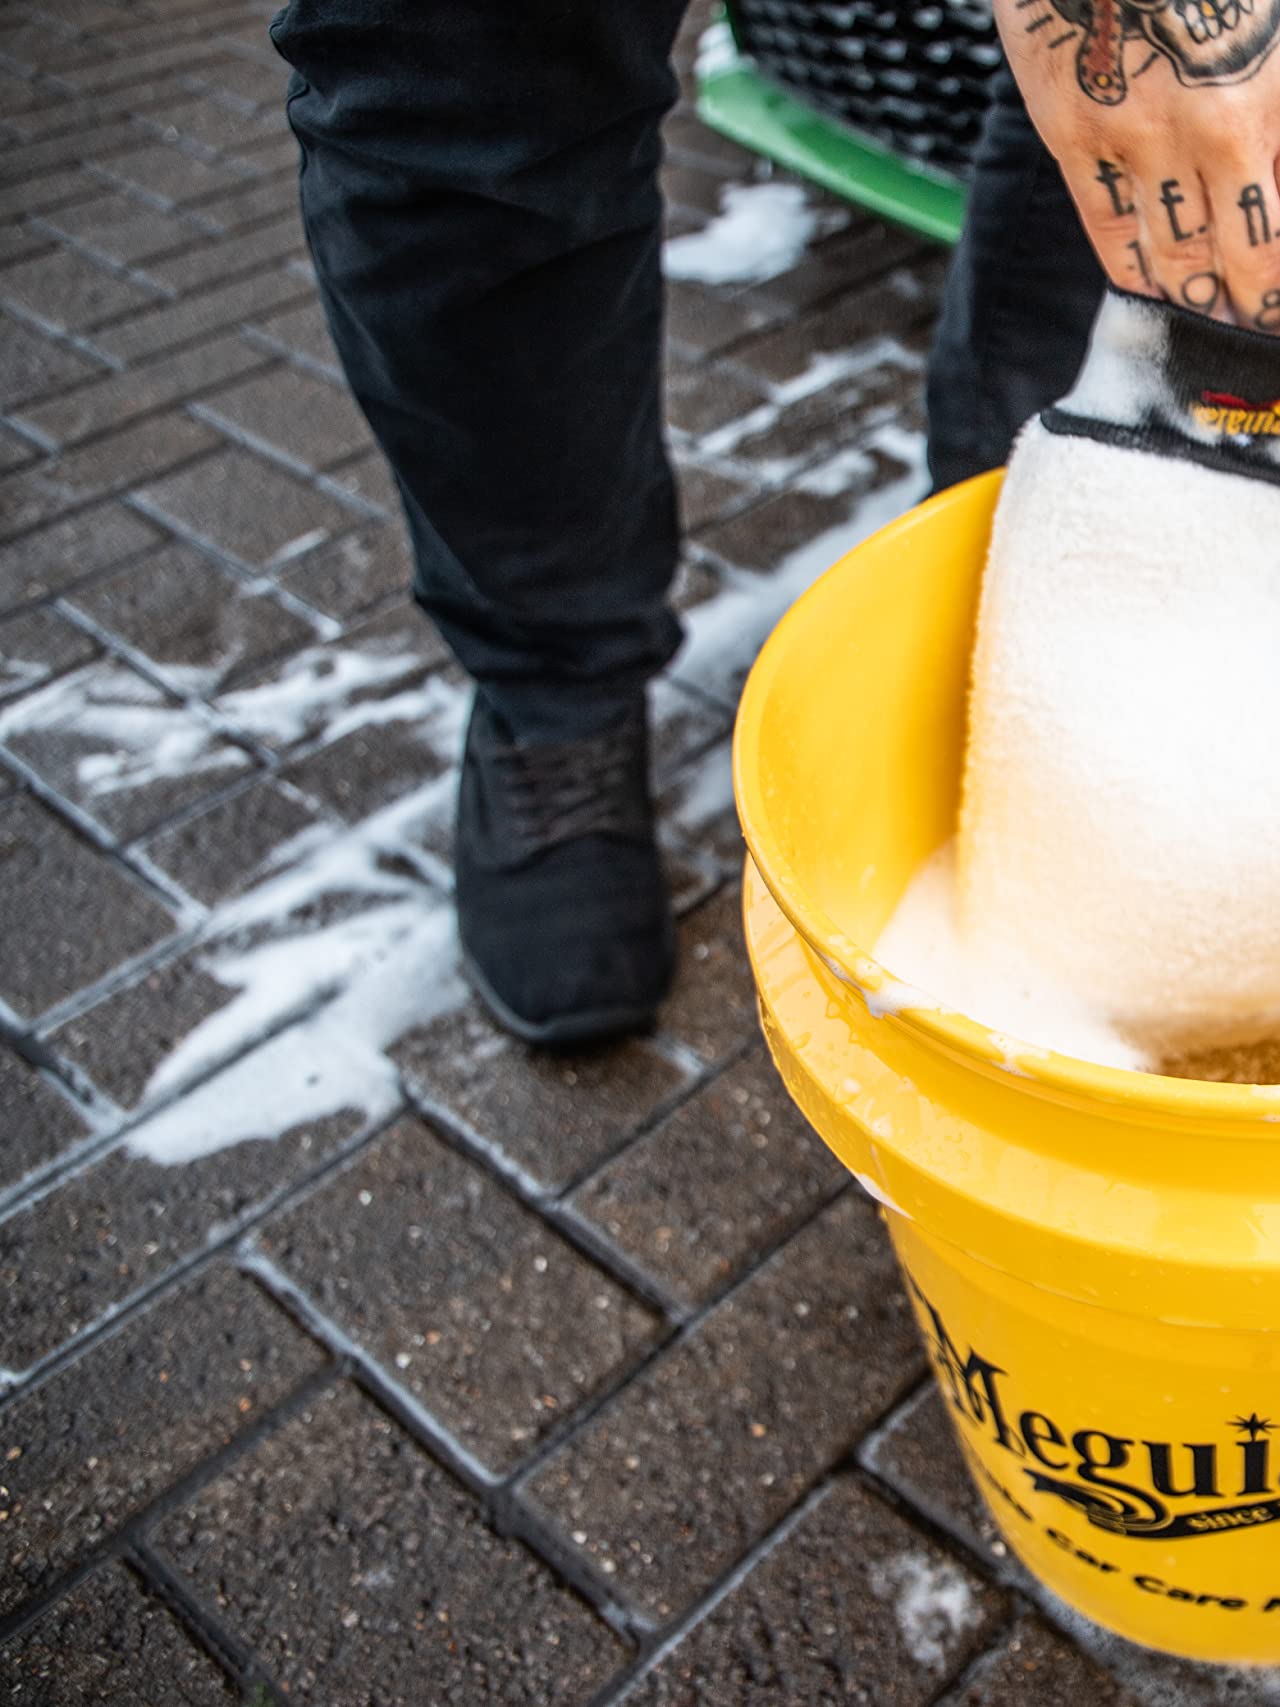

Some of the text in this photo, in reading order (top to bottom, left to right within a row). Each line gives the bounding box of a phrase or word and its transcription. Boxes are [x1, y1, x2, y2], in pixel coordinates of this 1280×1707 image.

[1186, 1505, 1274, 1532] since
[1045, 1526, 1122, 1573] Car
[1132, 1573, 1250, 1614] Care
